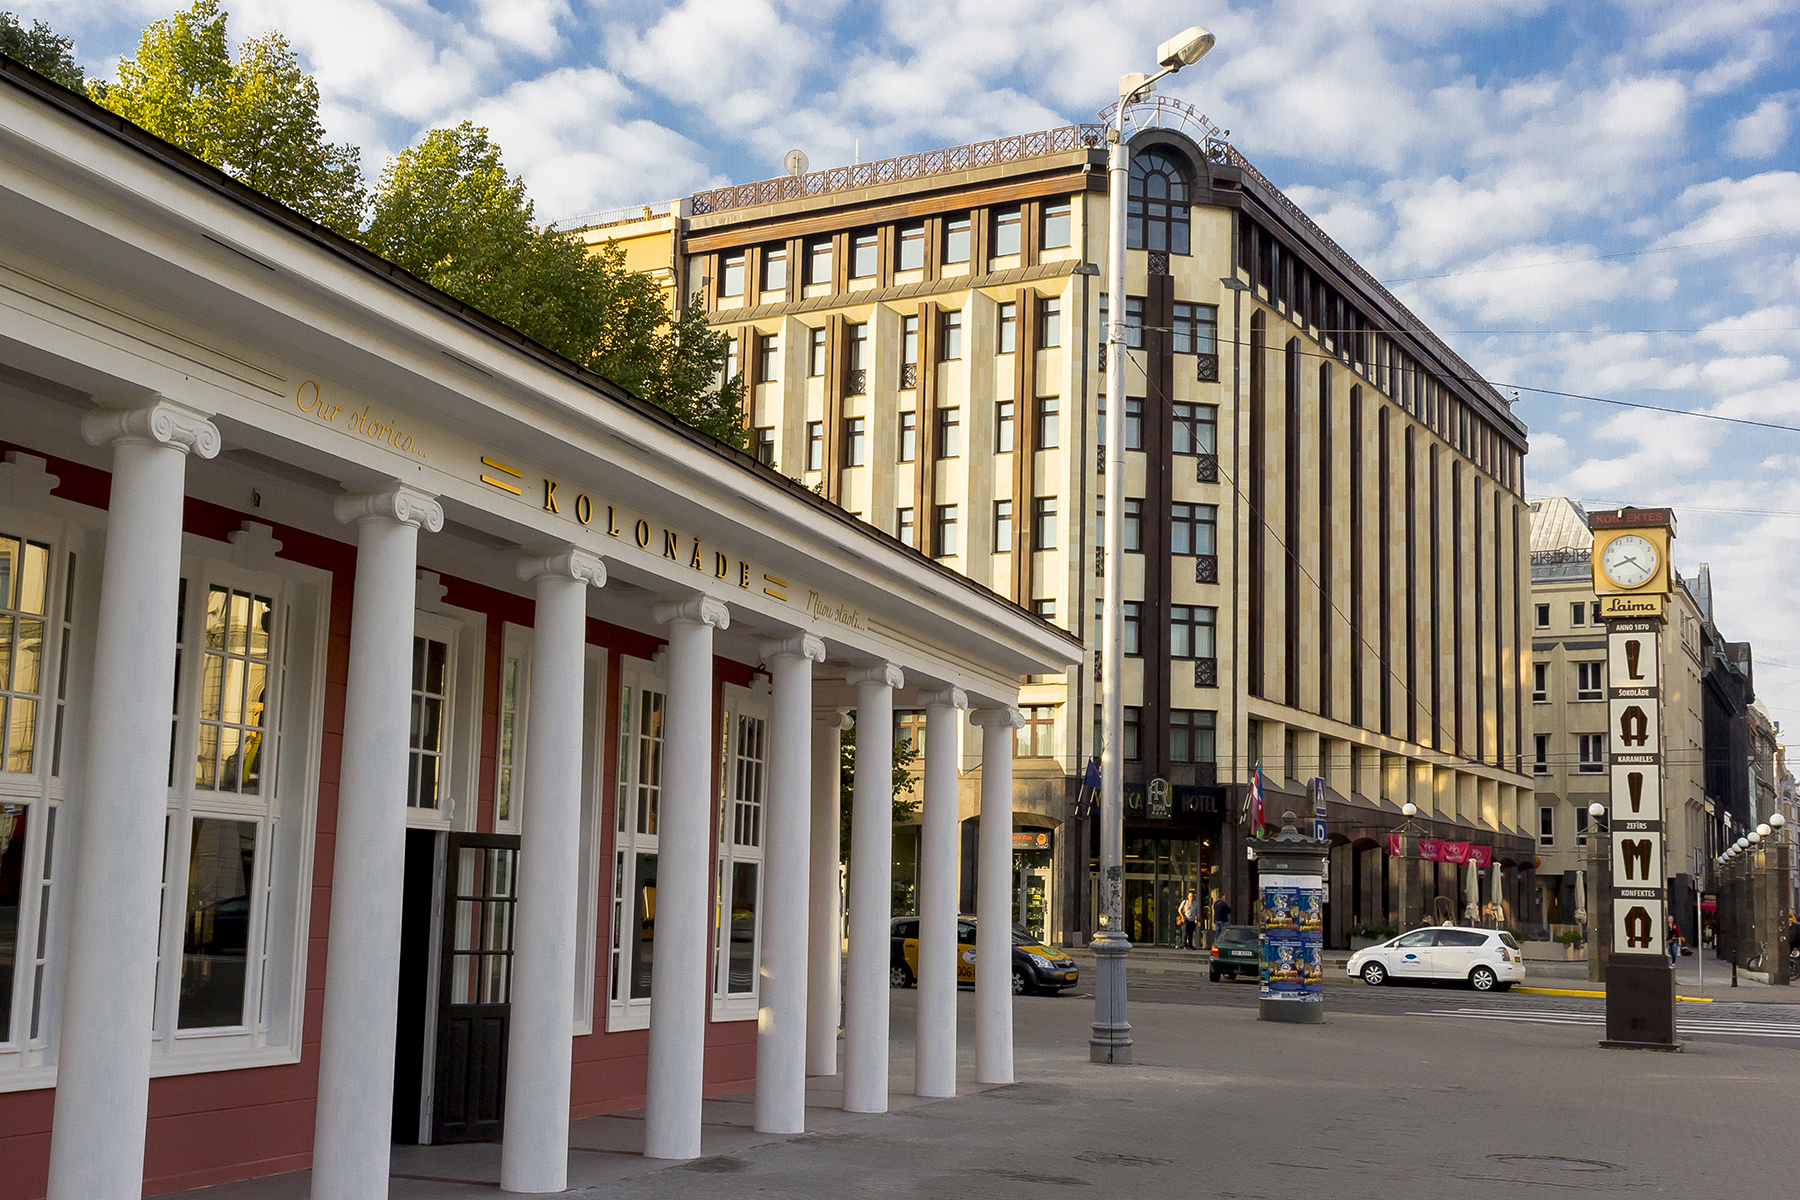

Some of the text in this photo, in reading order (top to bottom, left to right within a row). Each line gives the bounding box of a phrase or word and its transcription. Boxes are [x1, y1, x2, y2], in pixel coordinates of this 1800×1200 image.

[297, 380, 343, 422] Our
[1596, 512, 1663, 524] KONEKTES
[543, 478, 751, 588] KOLONĀDE
[806, 589, 834, 621] Mūsu
[1606, 598, 1656, 612] Laima
[1634, 623, 1650, 631] 1870
[1618, 688, 1650, 697] ŠOKOLĀDE
[1182, 795, 1217, 813] HOTEL
[1626, 822, 1648, 830] ZEFĪRS
[1621, 889, 1656, 897] KONFEKTES
